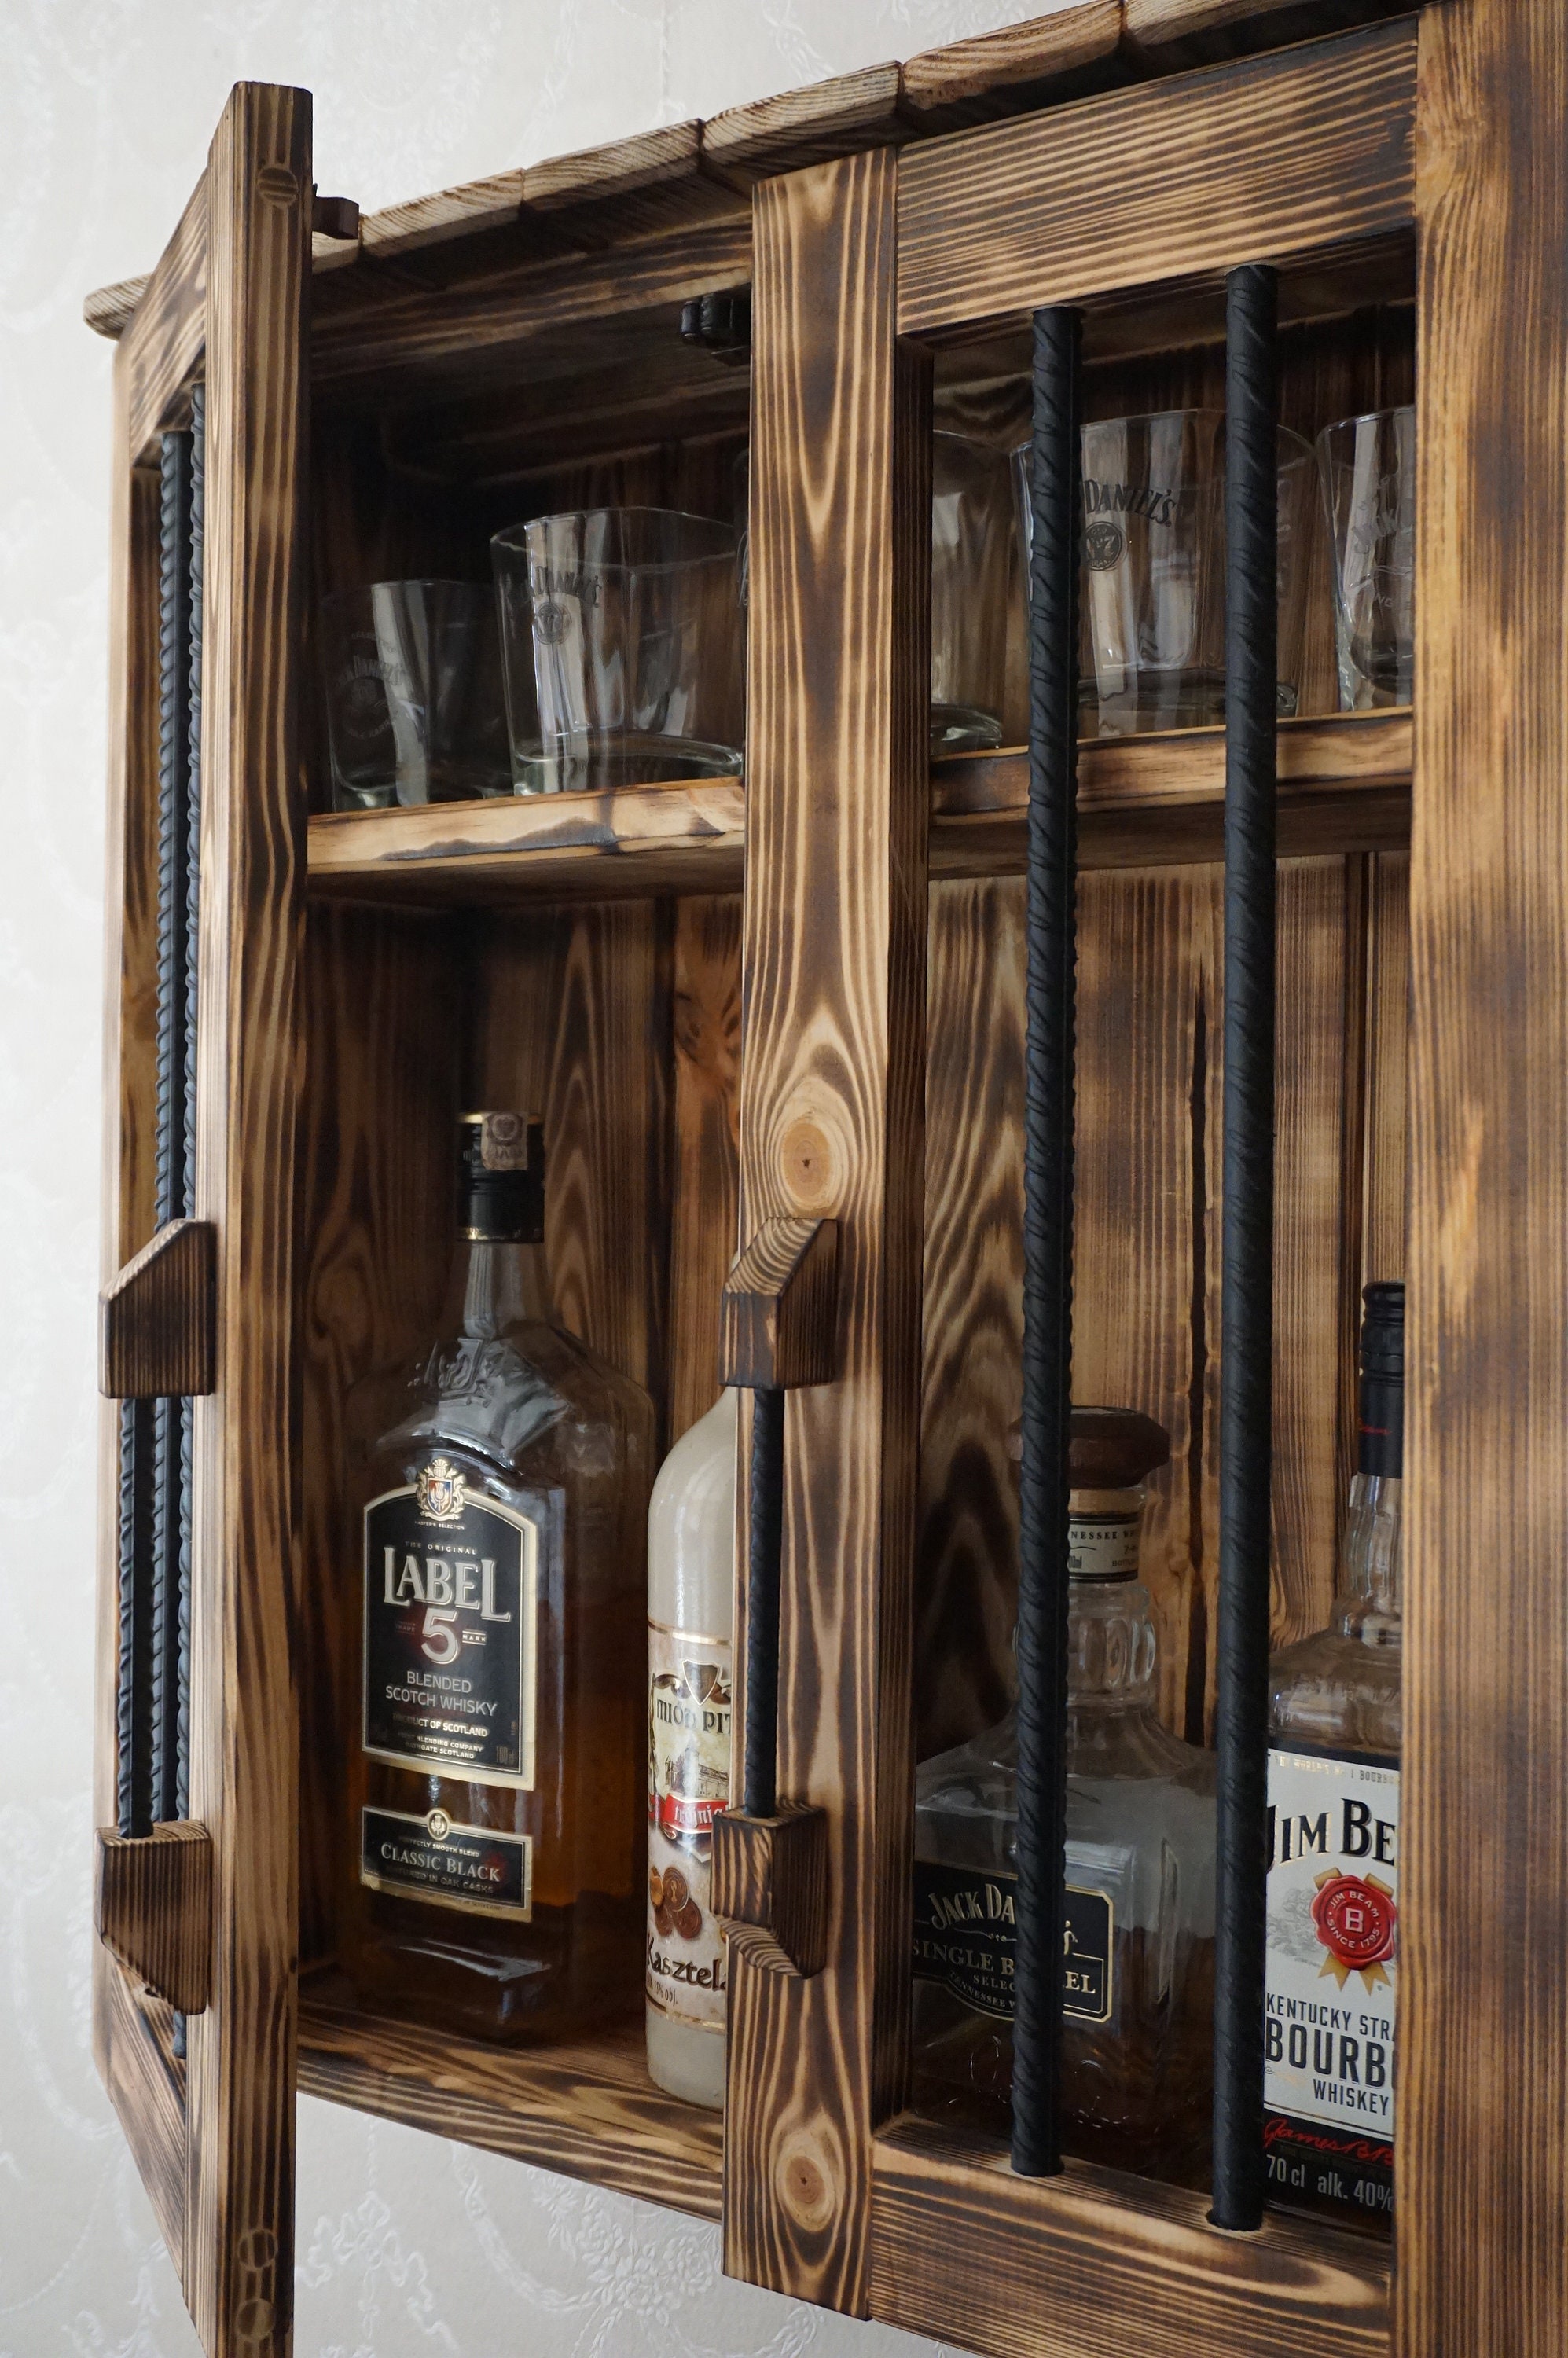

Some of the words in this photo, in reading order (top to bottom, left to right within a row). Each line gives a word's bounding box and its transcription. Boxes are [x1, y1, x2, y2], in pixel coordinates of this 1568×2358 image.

[428, 1544, 477, 1555] ORIGINAL
[1070, 1531, 1118, 1540] NESSEE
[384, 1546, 512, 1622] LABEL
[420, 1608, 460, 1665] 5
[462, 1634, 487, 1643] MARK
[406, 1670, 472, 1694] BLENDED
[385, 1685, 436, 1707] SCOTCH
[440, 1695, 498, 1717] WHISKY
[430, 1720, 441, 1729] OF
[442, 1722, 488, 1737] SCOTLAND
[703, 1710, 731, 1735] PIT
[439, 1747, 475, 1759] SCOTLAND
[450, 1742, 483, 1753] COMPANY
[432, 1843, 457, 1853] SMOOTH
[458, 1849, 479, 1857] BLEND
[1267, 1805, 1330, 1874] JIM
[1339, 1798, 1397, 1867] BE
[380, 1842, 441, 1871] CLASSIC
[446, 1857, 501, 1882] BLACK
[928, 1891, 983, 1930] JACK
[1330, 1893, 1345, 1909] JIM
[1350, 1891, 1379, 1918] BEAM
[1327, 1919, 1355, 1948] SINCE
[1361, 1928, 1380, 1948] 1795
[1346, 1908, 1364, 1933] B
[913, 1937, 993, 1972] SINGLE
[974, 1974, 1015, 1993] SELEC
[1266, 1993, 1351, 2031] KENTUCKY
[1360, 2015, 1394, 2041] STR
[1265, 2017, 1394, 2088] BOURB
[1313, 2079, 1389, 2115] WHISKEY
[1266, 2154, 1287, 2183] 70
[1291, 2164, 1305, 2188] cl
[1318, 2172, 1348, 2199] alk.
[1353, 2180, 1394, 2213] 40%
